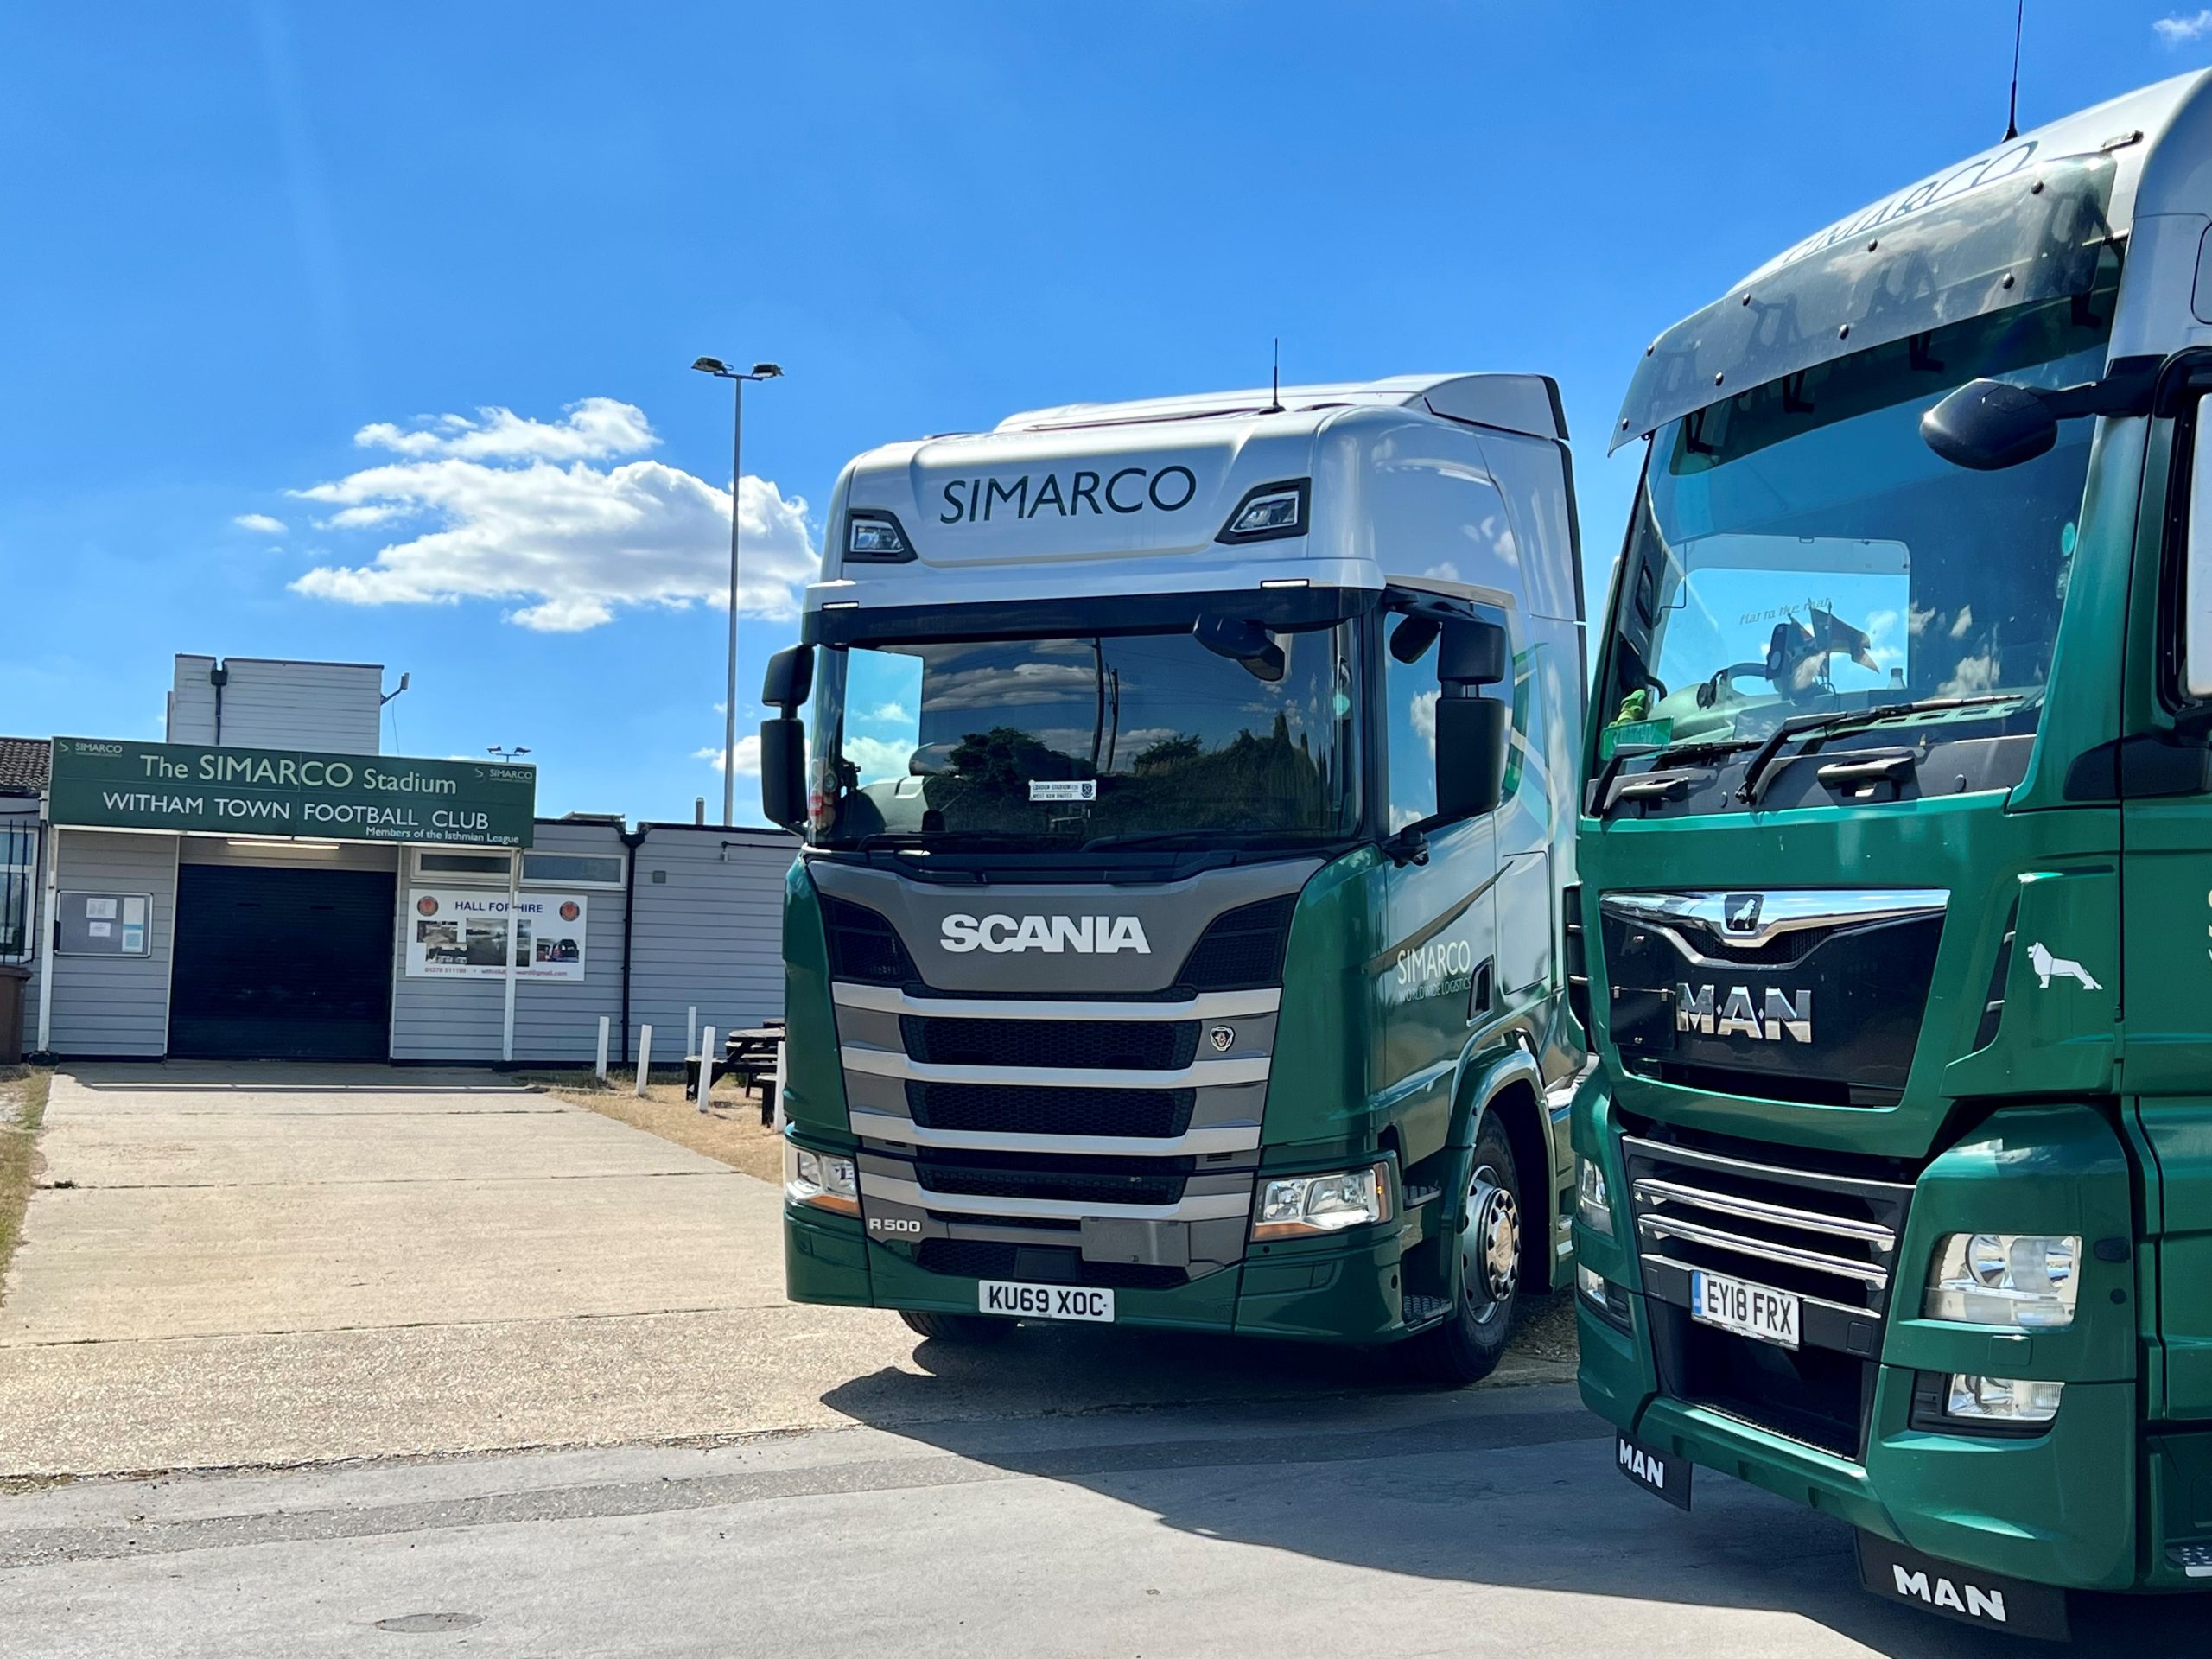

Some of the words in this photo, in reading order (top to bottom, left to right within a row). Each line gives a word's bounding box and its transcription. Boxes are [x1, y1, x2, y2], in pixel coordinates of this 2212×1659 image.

[939, 465, 1197, 524] SIMARCO
[75, 742, 123, 753] SIMARCO
[140, 754, 188, 779] The
[199, 753, 353, 788] SIMARCO
[363, 768, 457, 795] Stadium
[489, 769, 533, 780] SIMARCO
[103, 791, 204, 815] WITHAM
[214, 798, 290, 820] TOWN
[304, 804, 419, 826] FOOTBALL
[432, 810, 489, 830] CLUB
[365, 826, 411, 838] Members
[413, 830, 423, 838] of
[427, 830, 442, 840] the
[445, 831, 484, 842] Isthmian
[487, 833, 519, 845] League
[455, 901, 486, 911] HALL
[517, 903, 543, 913] HIRE
[940, 914, 1151, 954] SCANIA
[1397, 940, 1470, 985] SIMARCO
[1676, 982, 1812, 1044] MAN
[989, 1286, 1049, 1313] KU69
[1057, 1290, 1103, 1316] XOC
[1707, 1280, 1747, 1321] EY18
[1753, 1292, 1792, 1335] FRX
[1620, 1438, 1664, 1489] MAN
[1892, 1564, 2006, 1622] MAN
